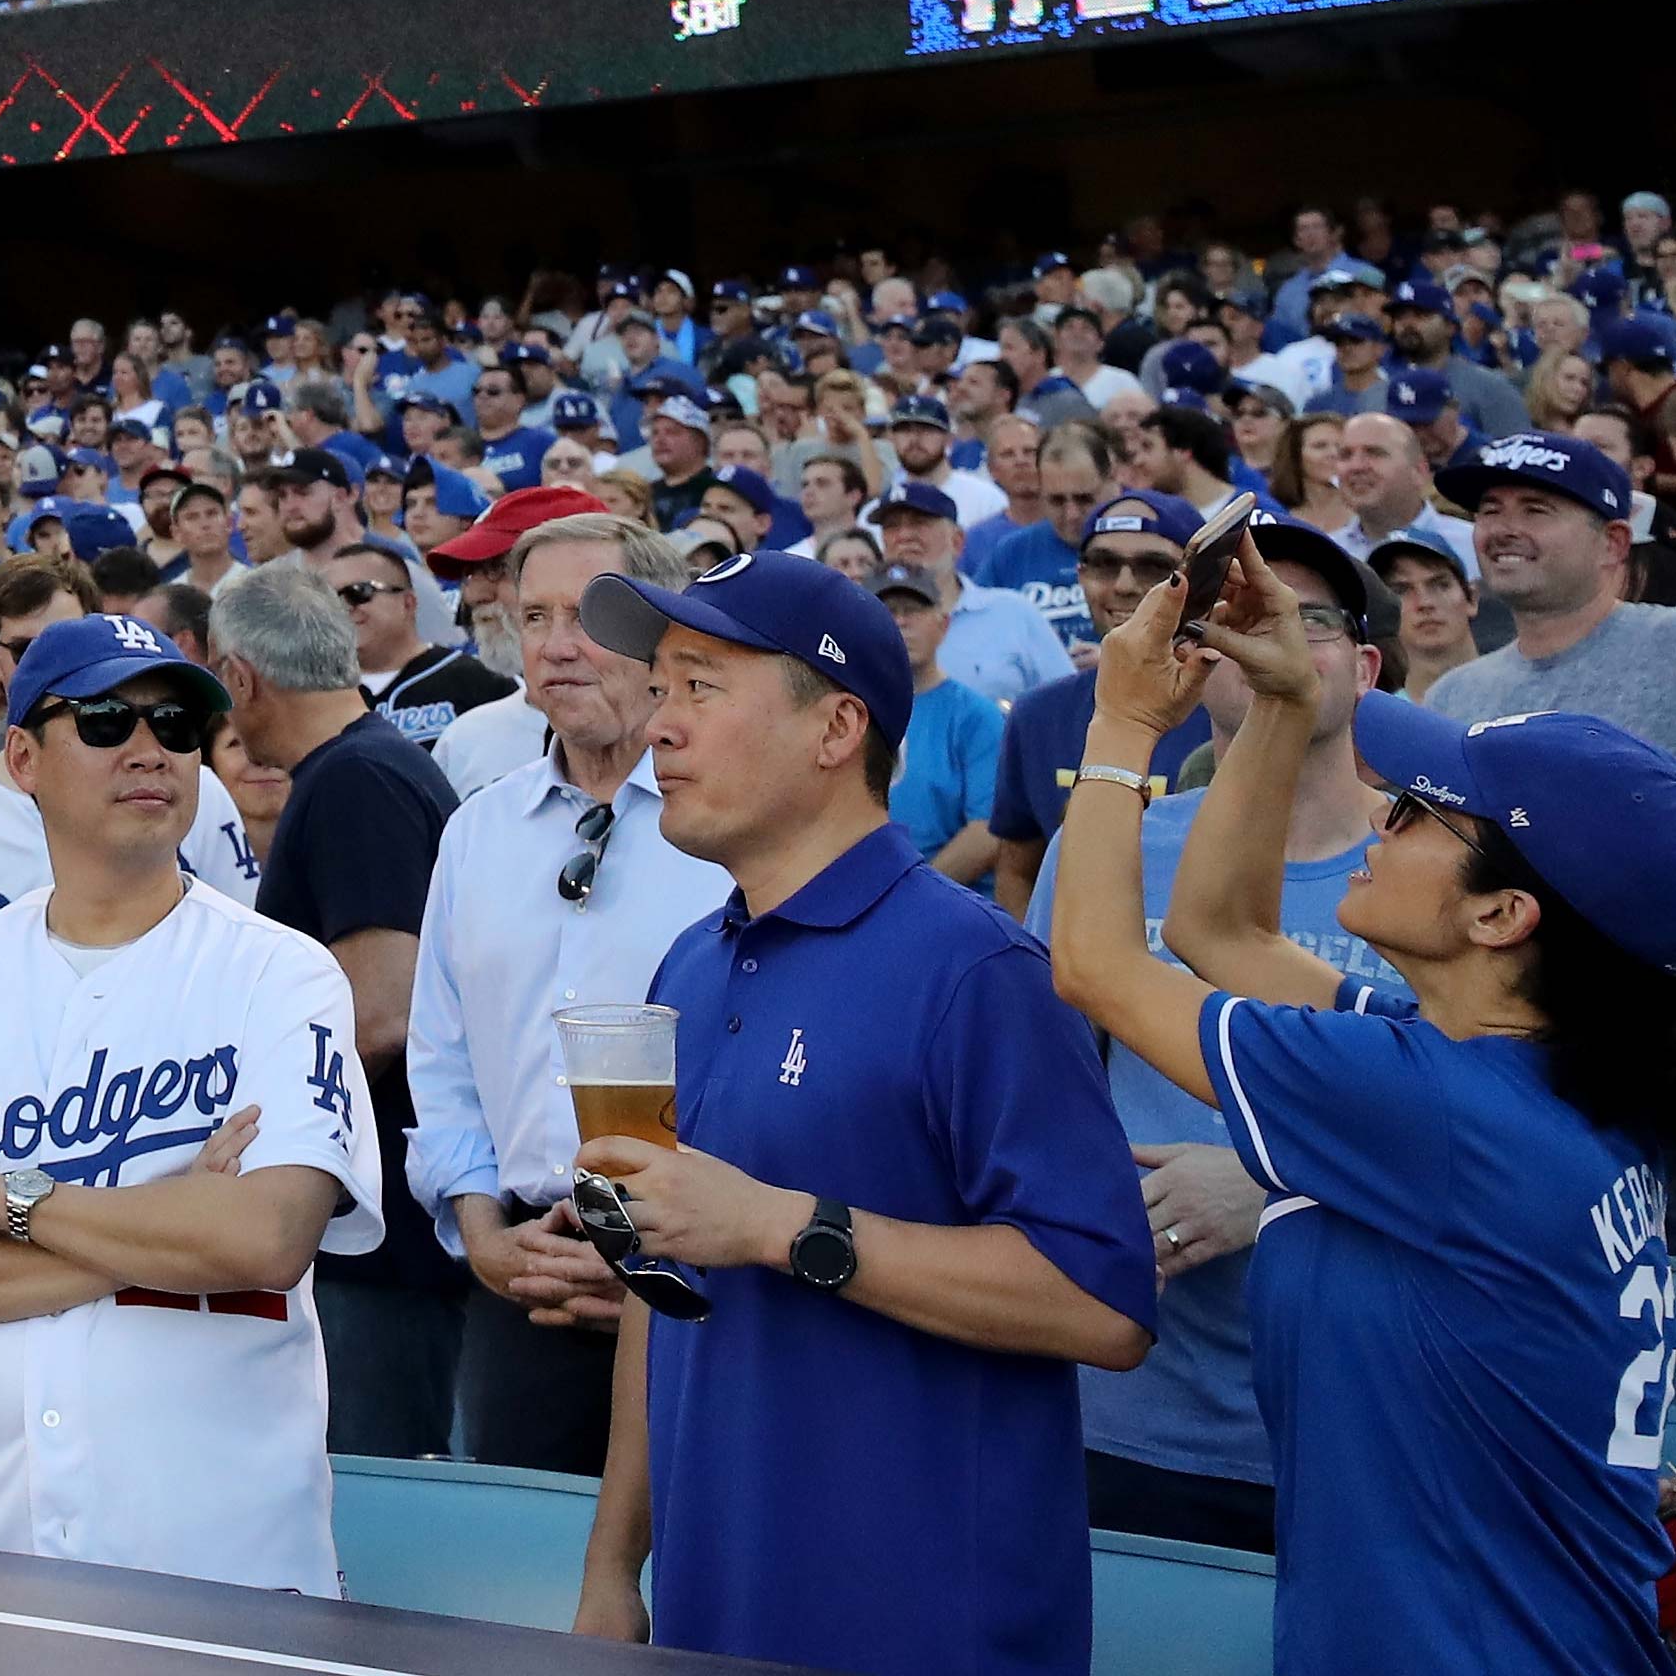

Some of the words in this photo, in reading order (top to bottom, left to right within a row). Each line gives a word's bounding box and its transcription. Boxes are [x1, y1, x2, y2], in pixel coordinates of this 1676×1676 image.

[103, 614, 160, 653] LA
[1409, 774, 1467, 806] Dodgers
[306, 1022, 353, 1134] LA
[778, 1028, 807, 1087] LA
